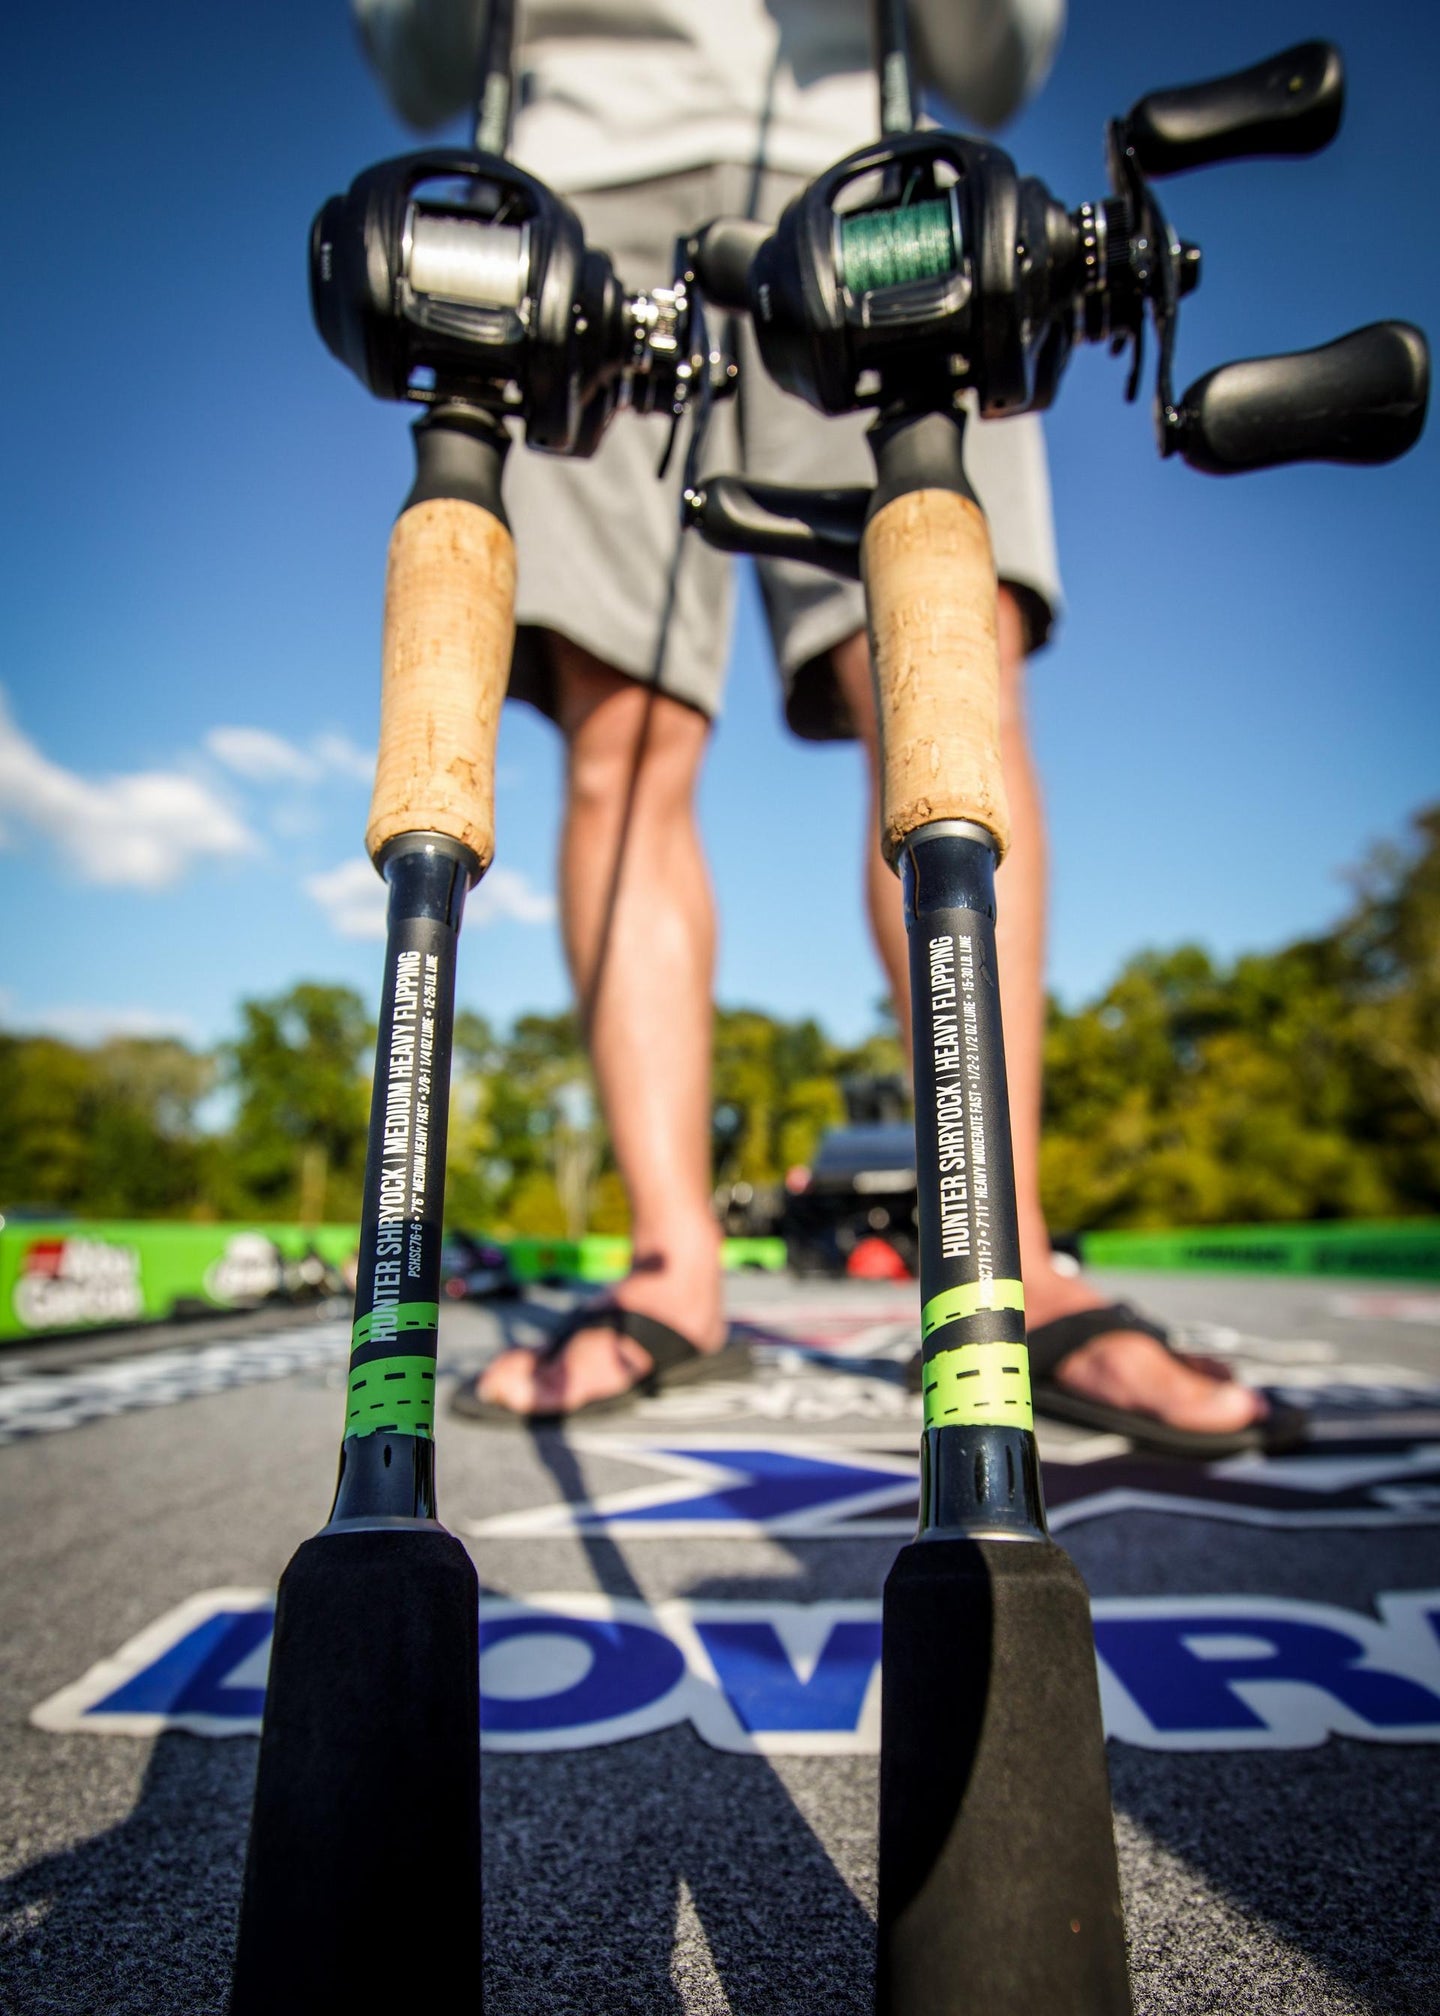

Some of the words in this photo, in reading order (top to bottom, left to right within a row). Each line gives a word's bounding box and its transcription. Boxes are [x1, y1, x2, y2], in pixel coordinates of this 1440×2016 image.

[959, 935, 972, 953] LINE
[426, 954, 438, 972] LINE
[929, 935, 956, 1011] FLIPPING
[394, 951, 420, 1020] FLIPPING
[961, 968, 974, 991] 15-30
[423, 985, 436, 1009] 12-25
[963, 1001, 976, 1023] LURE
[421, 1017, 434, 1038] LURE
[964, 1023, 977, 1035] OZ
[389, 1025, 416, 1078] HEAVY
[421, 1038, 433, 1050] OZ
[932, 1014, 960, 1073] HEAVY
[965, 1037, 978, 1051] 1/2
[420, 1051, 433, 1065] 1/4
[966, 1054, 980, 1081] 1/2-2
[418, 1069, 431, 1094] 3/8-1
[416, 1101, 429, 1124] FAST
[968, 1090, 982, 1113] FAST
[383, 1082, 412, 1155] MEDIUM
[936, 1082, 964, 1172] SHRYOCK
[415, 1124, 428, 1154] HEAVY
[970, 1115, 986, 1165] MODERATE
[413, 1155, 426, 1192] MEDIUM
[973, 1165, 988, 1198] HEAVY
[376, 1167, 407, 1255] SHRYOCK
[940, 1175, 970, 1259] HUNTER
[408, 1224, 422, 1278] PSHSC76-6
[370, 1261, 401, 1342] HUNTER
